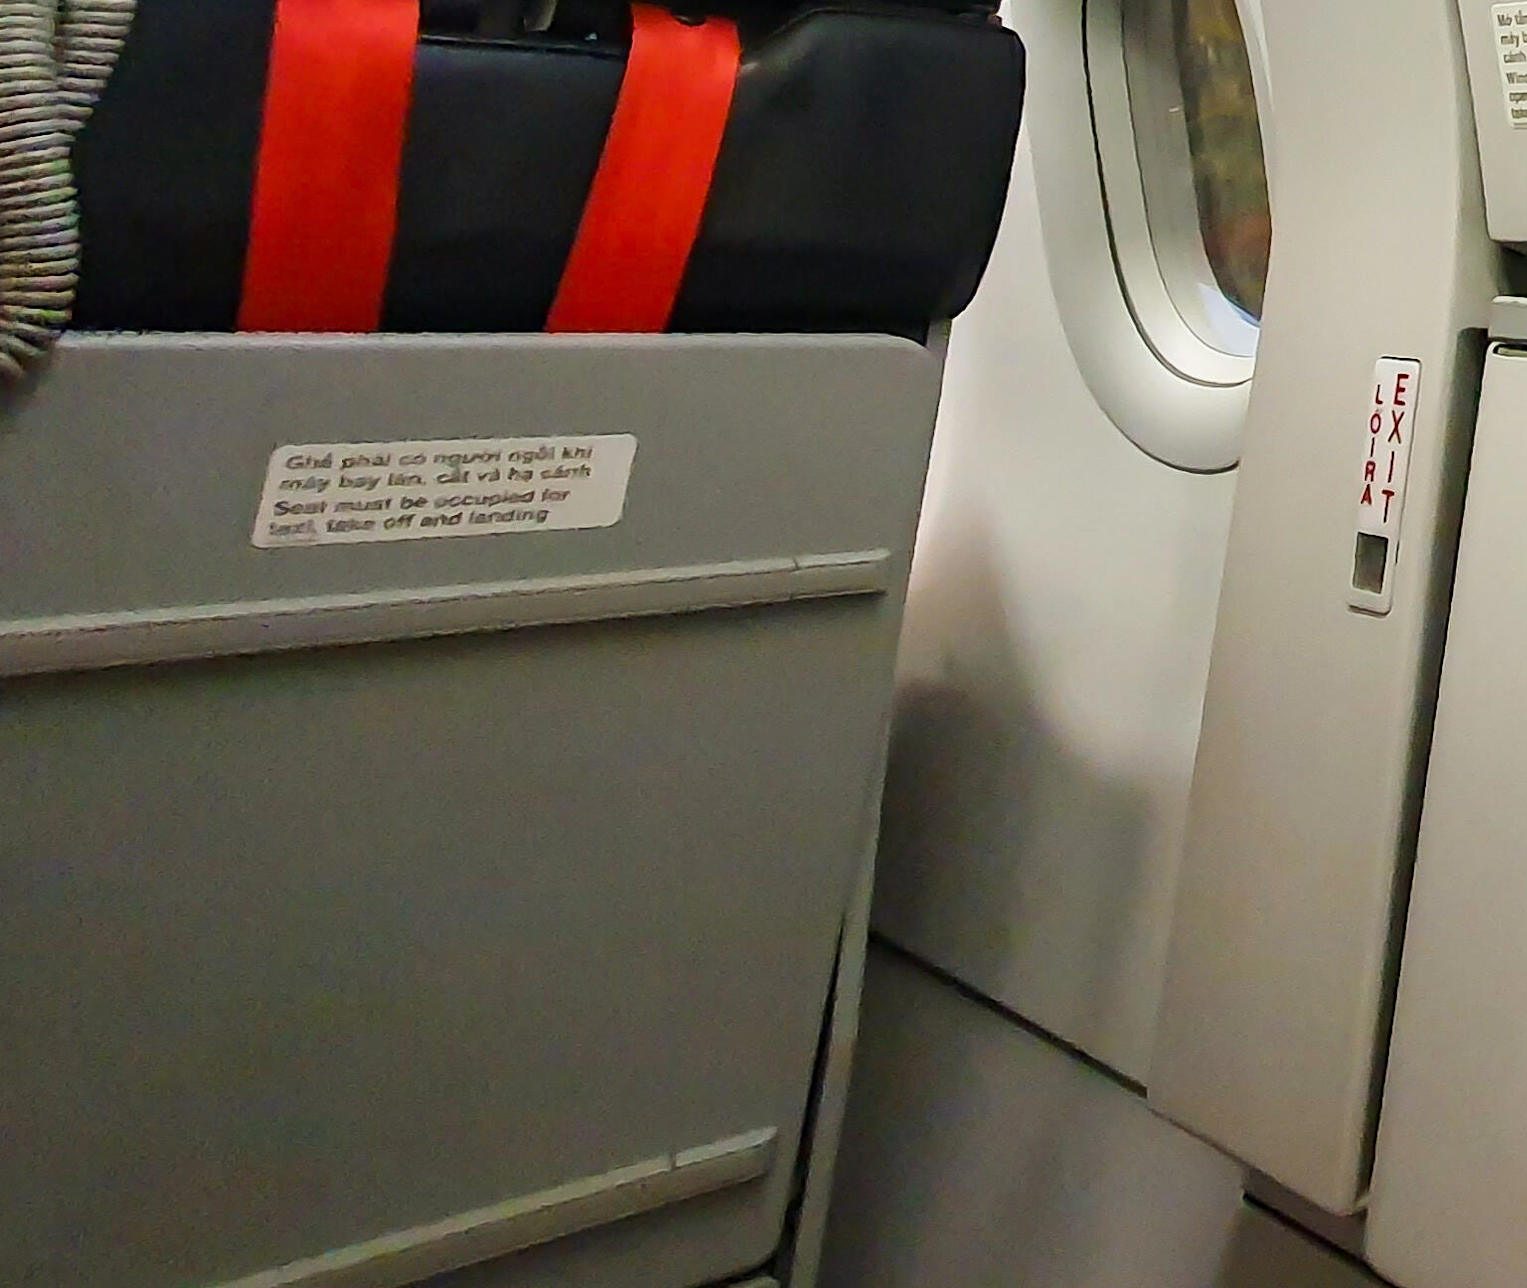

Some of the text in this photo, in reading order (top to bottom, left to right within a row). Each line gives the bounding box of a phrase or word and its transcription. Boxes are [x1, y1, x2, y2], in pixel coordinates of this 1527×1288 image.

[1380, 373, 1410, 524] EXIT
[274, 488, 571, 517] Seat must be occupied for
[384, 514, 416, 532] off
[421, 511, 463, 528] and
[468, 506, 550, 527] landing
